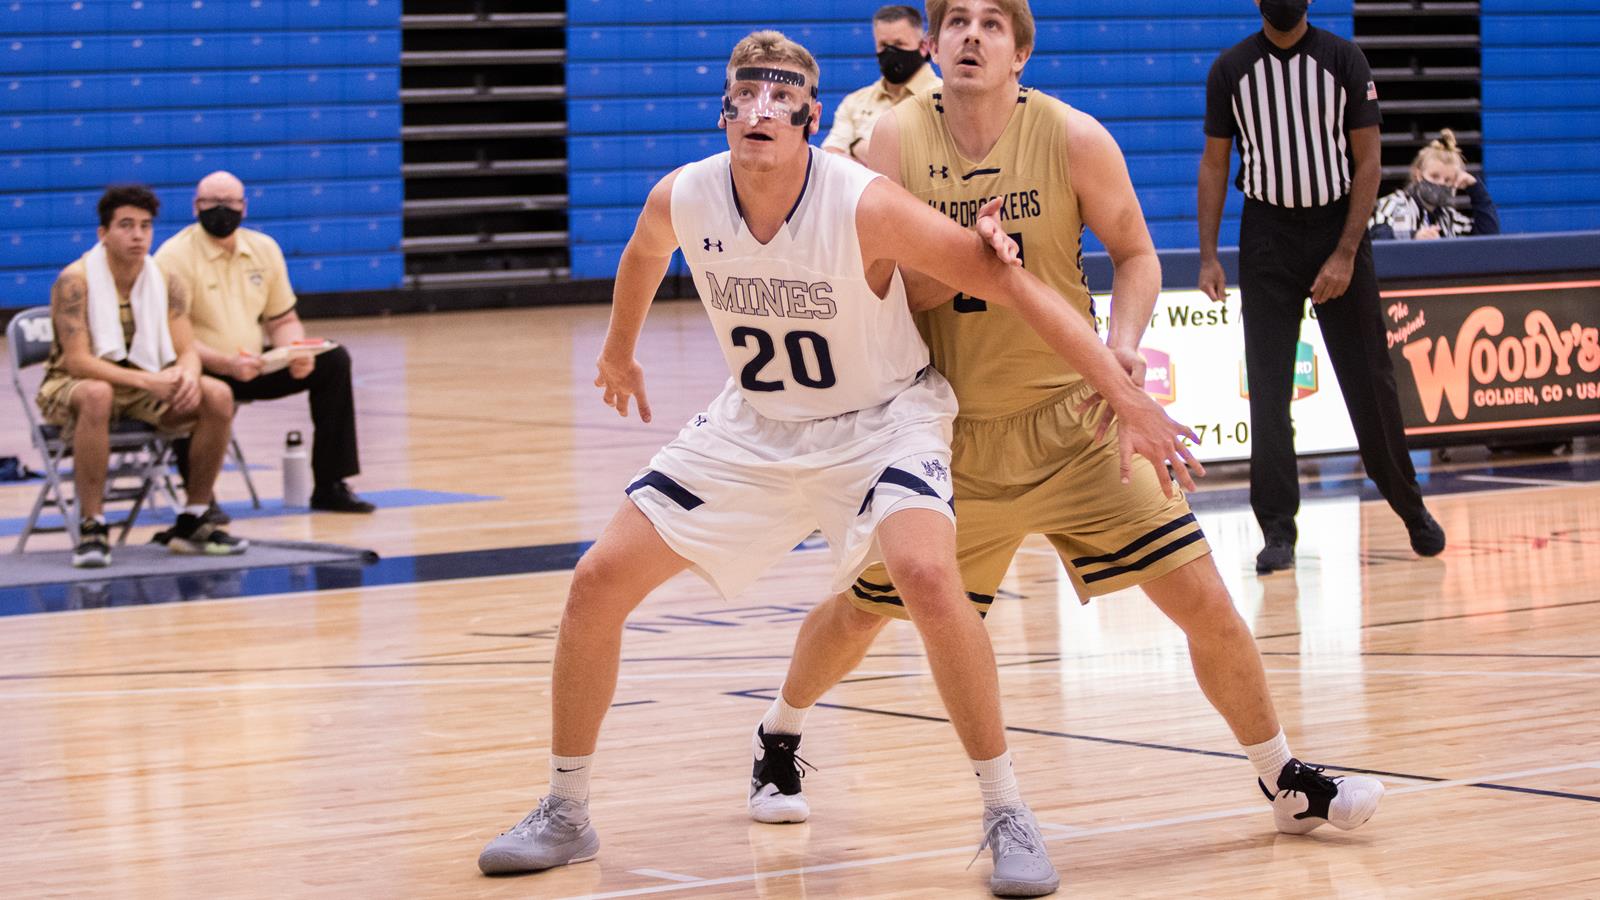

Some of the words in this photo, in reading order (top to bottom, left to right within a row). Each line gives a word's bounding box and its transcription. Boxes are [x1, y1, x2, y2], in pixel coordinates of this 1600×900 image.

[705, 271, 838, 320] MINES
[1167, 304, 1229, 327] West
[1387, 301, 1409, 323] The
[731, 326, 837, 392] 20
[1473, 385, 1539, 407] GOLDEN,
[1541, 384, 1564, 403] CO
